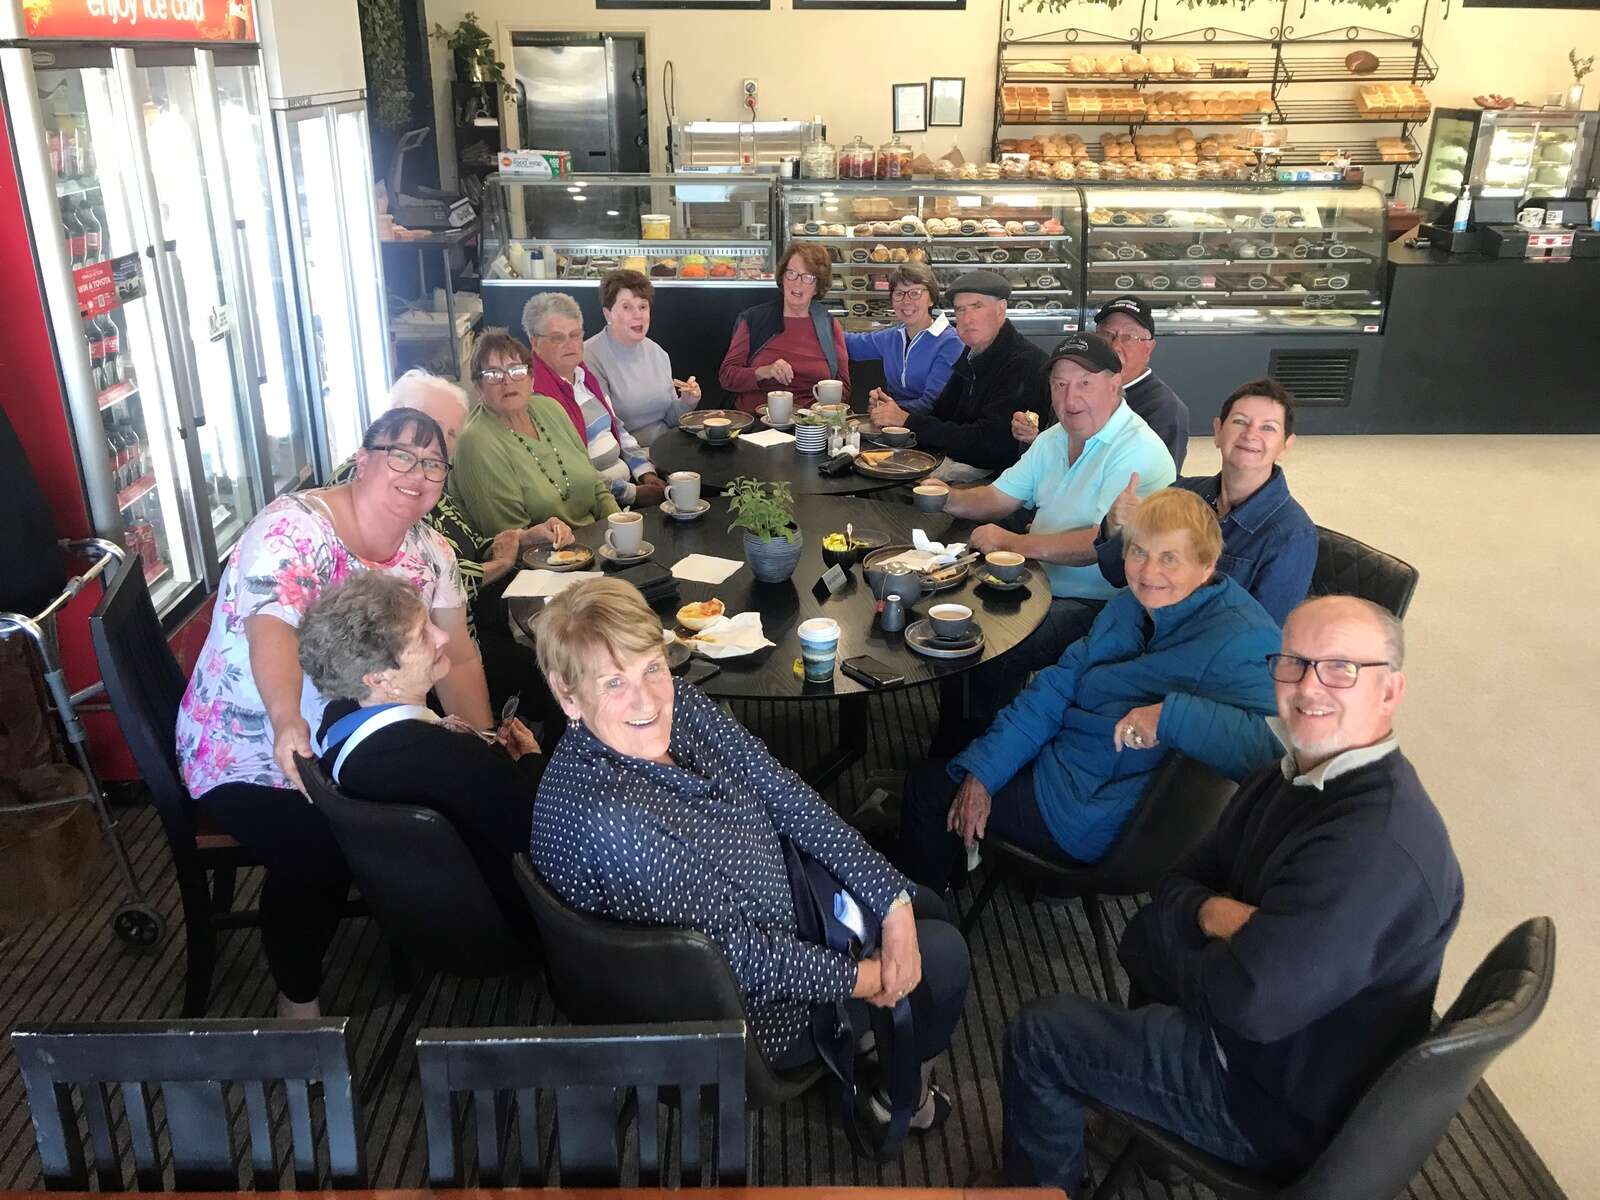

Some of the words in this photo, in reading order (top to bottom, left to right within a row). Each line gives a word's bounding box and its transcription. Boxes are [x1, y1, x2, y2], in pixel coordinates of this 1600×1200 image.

[87, 0, 137, 24] enjoy
[143, 0, 168, 19] ice
[171, 0, 205, 21] cold
[92, 276, 111, 288] TOYOTA
